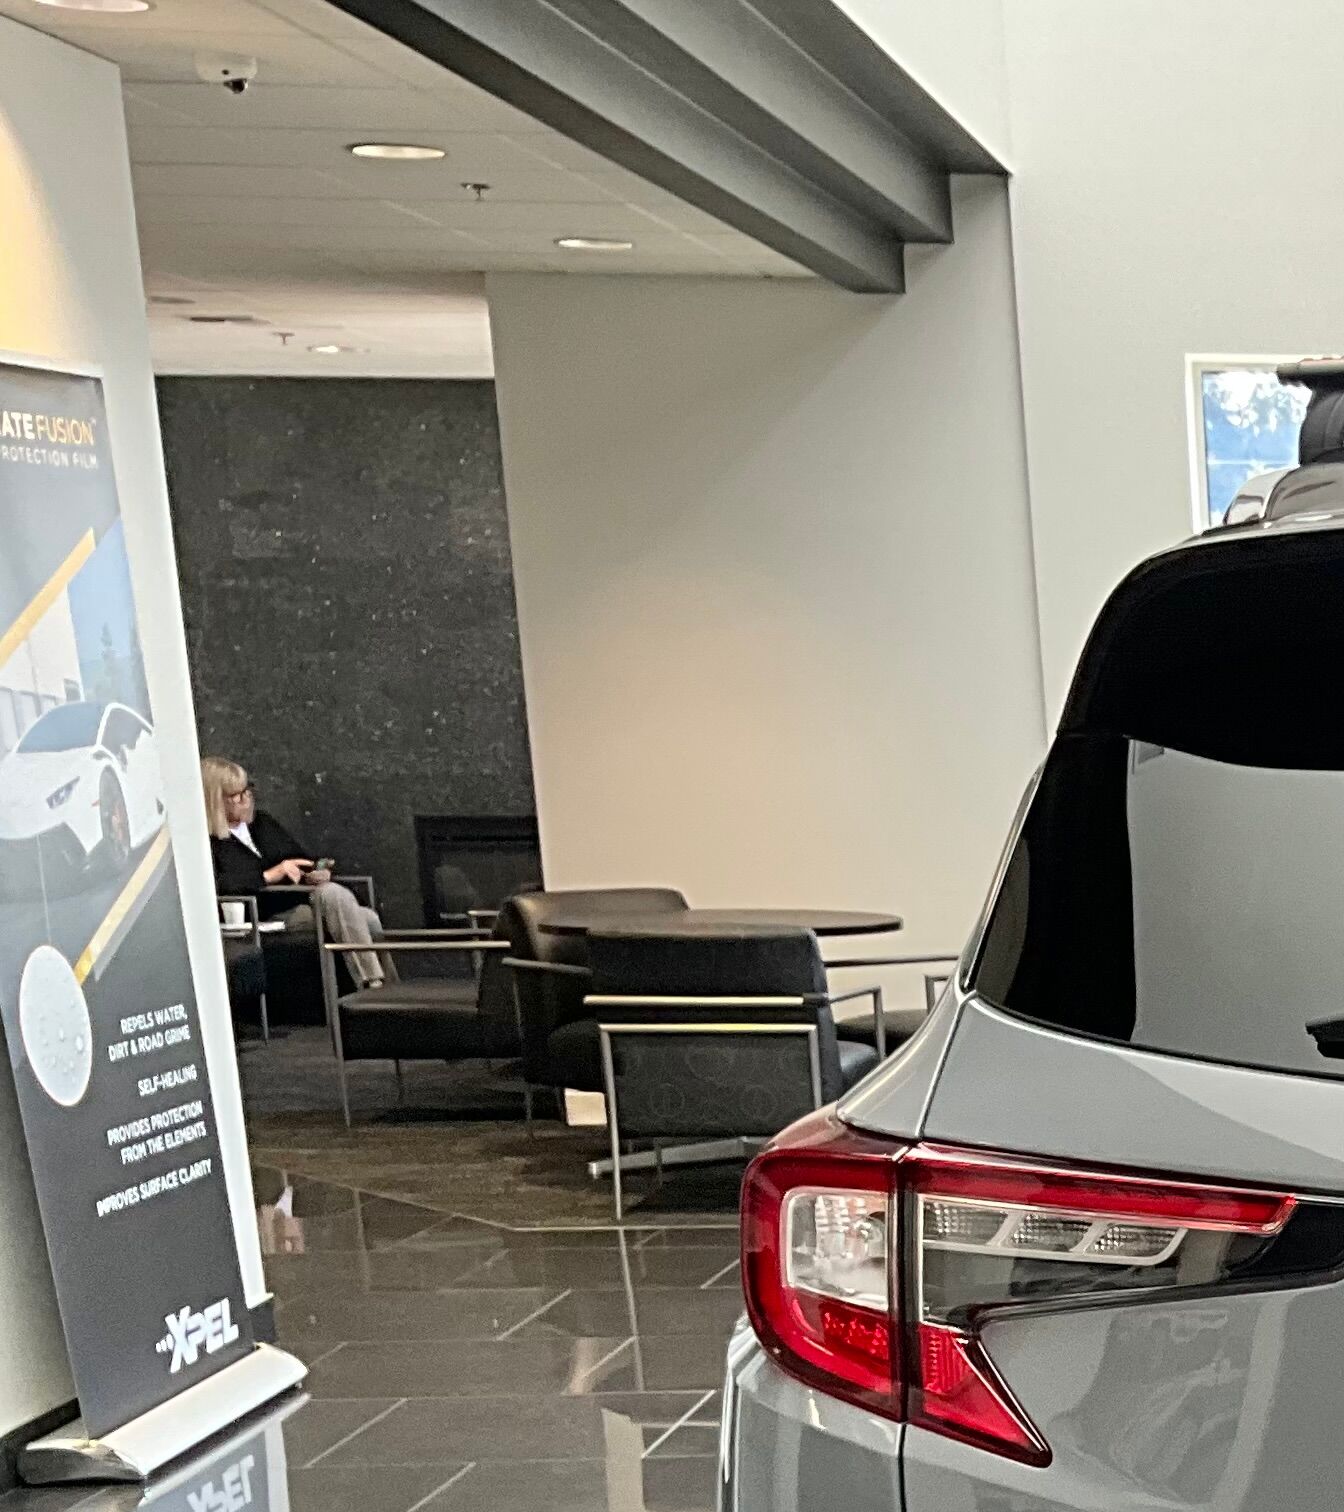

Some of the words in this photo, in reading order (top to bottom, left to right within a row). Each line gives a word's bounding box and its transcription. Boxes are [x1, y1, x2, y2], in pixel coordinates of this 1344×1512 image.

[0, 411, 35, 440] ATE
[1, 445, 70, 467] ROTECTION
[72, 451, 98, 469] FILM
[120, 1011, 155, 1035] REPELS
[154, 1004, 188, 1026] WATER,
[108, 1041, 129, 1062] DIRT
[138, 1031, 164, 1053] ROAD
[164, 1024, 191, 1046] GRIME
[137, 1063, 198, 1097] SELF-HEALING
[107, 1117, 151, 1146] PROVIDES
[150, 1100, 203, 1131] PROTECTION
[120, 1142, 148, 1165] FROM
[146, 1135, 165, 1155] THE
[164, 1120, 207, 1149] ELEMENTS
[96, 1186, 140, 1217] IMPROVES
[139, 1170, 179, 1200] SURFACE
[178, 1158, 212, 1185] CLARITY
[165, 1297, 239, 1374] XPEL
